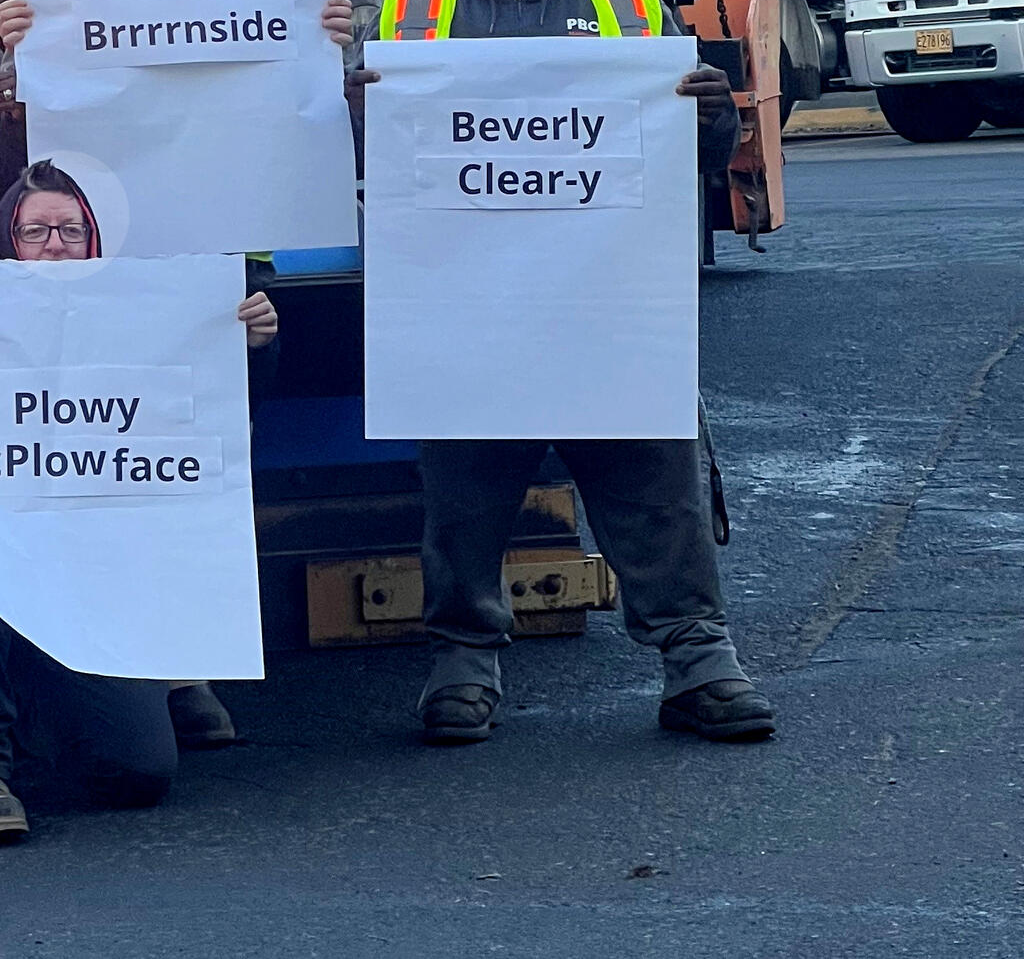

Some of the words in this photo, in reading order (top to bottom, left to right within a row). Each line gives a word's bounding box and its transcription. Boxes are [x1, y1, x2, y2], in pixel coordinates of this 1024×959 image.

[83, 10, 288, 51] Brrrrnside
[566, 18, 600, 32] PBO
[916, 33, 951, 48] E278196
[452, 107, 605, 150] Beverly
[458, 162, 602, 205] Clear-y
[14, 389, 141, 433] Plowy
